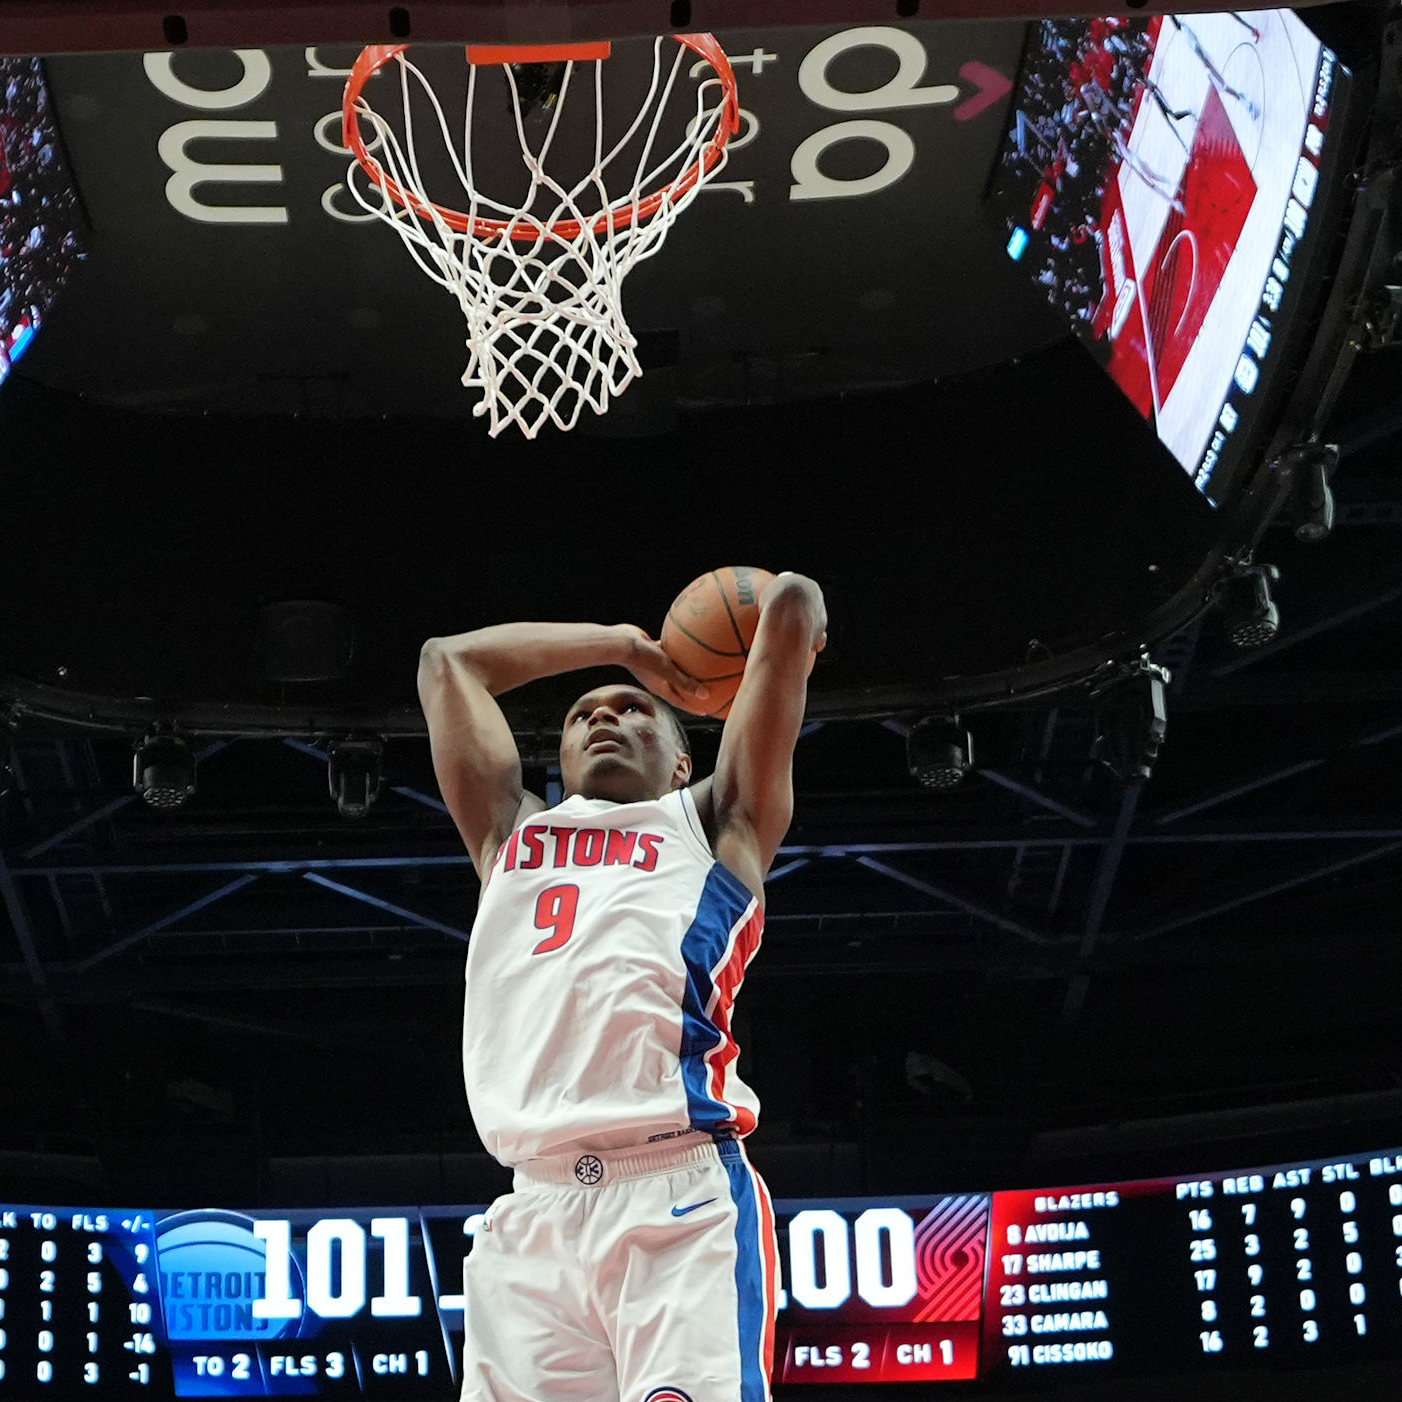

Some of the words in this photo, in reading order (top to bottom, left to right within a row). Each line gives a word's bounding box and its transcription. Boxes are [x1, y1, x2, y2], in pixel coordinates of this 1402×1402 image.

[533, 884, 579, 955] 9
[1176, 1180, 1214, 1200] PTS
[1223, 1175, 1264, 1195] REB
[1273, 1168, 1311, 1189] AST
[1322, 1162, 1359, 1183] STL
[1034, 1191, 1119, 1212] BLAZERS
[30, 1213, 56, 1230] TO
[72, 1214, 109, 1231] FLS
[122, 1216, 149, 1233] +/-
[1006, 1224, 1021, 1246] 8
[1025, 1222, 1089, 1243] AVDIJA
[252, 1218, 421, 1318] 101
[779, 1208, 918, 1309] 00
[1001, 1254, 1023, 1275] 17
[1027, 1250, 1100, 1274] SHARPE
[1000, 1284, 1025, 1307] 23
[1029, 1280, 1107, 1303] CLINGAN
[1002, 1314, 1027, 1336] 33
[1031, 1311, 1108, 1334] CAMARA
[271, 1356, 317, 1376] FLS
[325, 1352, 344, 1378] 3
[372, 1354, 407, 1374] CH
[415, 1350, 428, 1376] 1
[795, 1346, 843, 1367] FLS
[851, 1342, 870, 1369] 2
[897, 1343, 932, 1364] CH
[940, 1339, 954, 1365] 1
[1008, 1344, 1029, 1366] 91
[1033, 1341, 1113, 1363] CISSOKO
[193, 1356, 224, 1375] TO
[232, 1354, 250, 1379] 2
